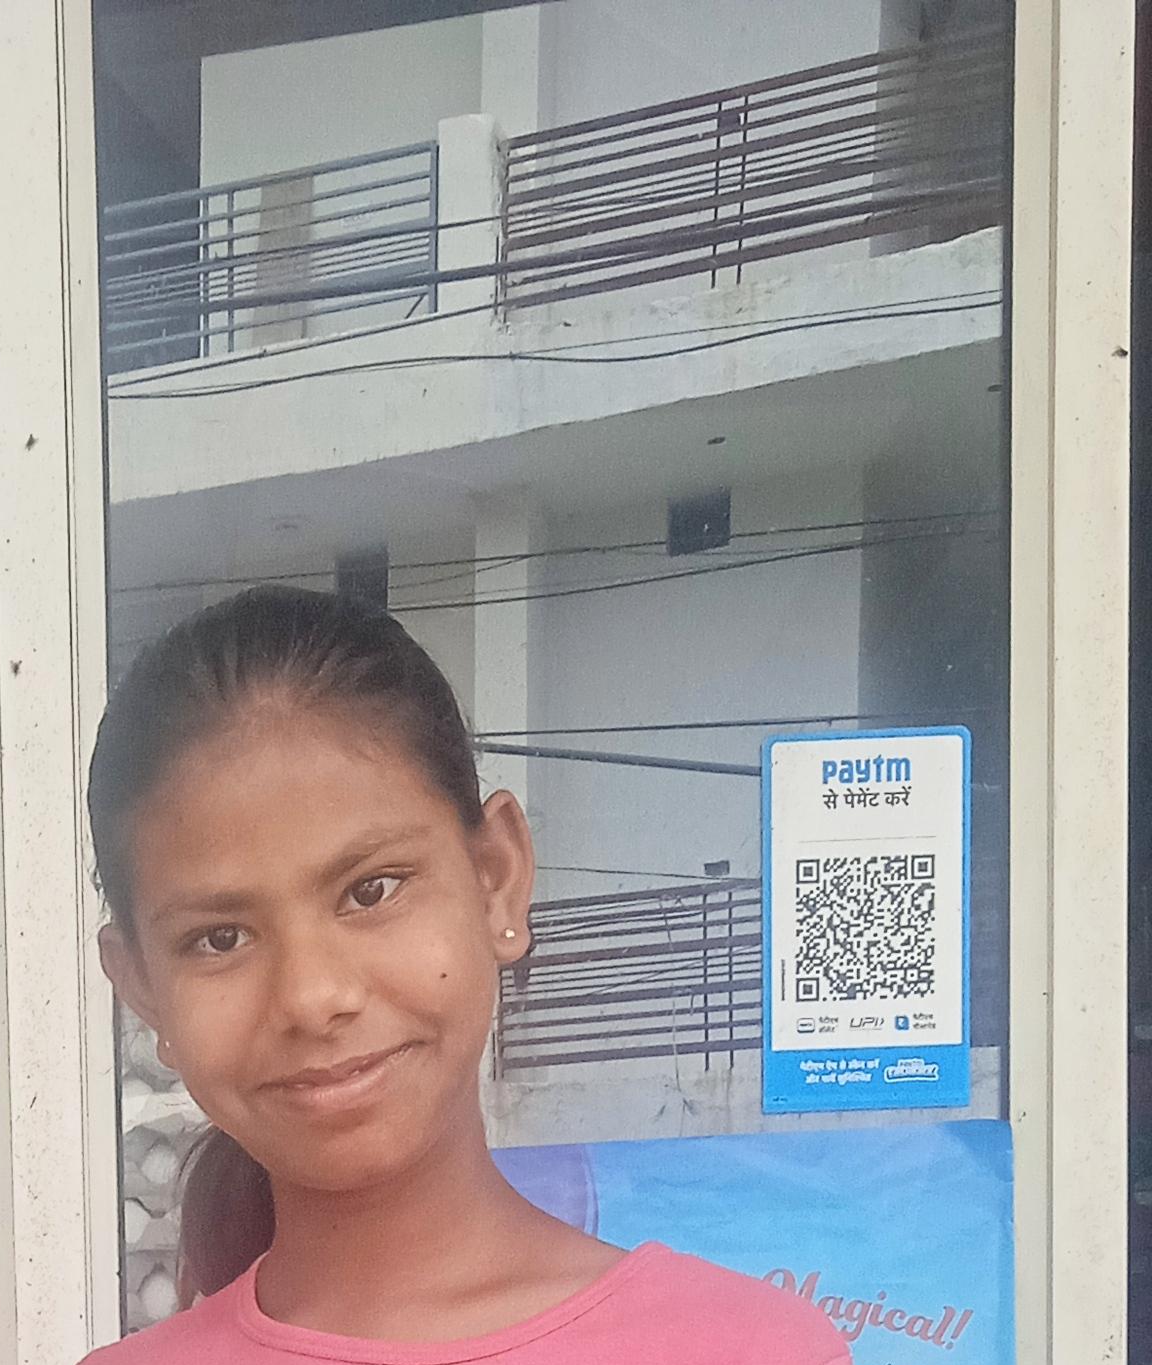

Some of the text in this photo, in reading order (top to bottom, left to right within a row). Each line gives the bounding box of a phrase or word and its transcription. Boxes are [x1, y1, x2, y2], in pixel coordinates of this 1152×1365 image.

[822, 785, 912, 809] से पेमेंट करें
